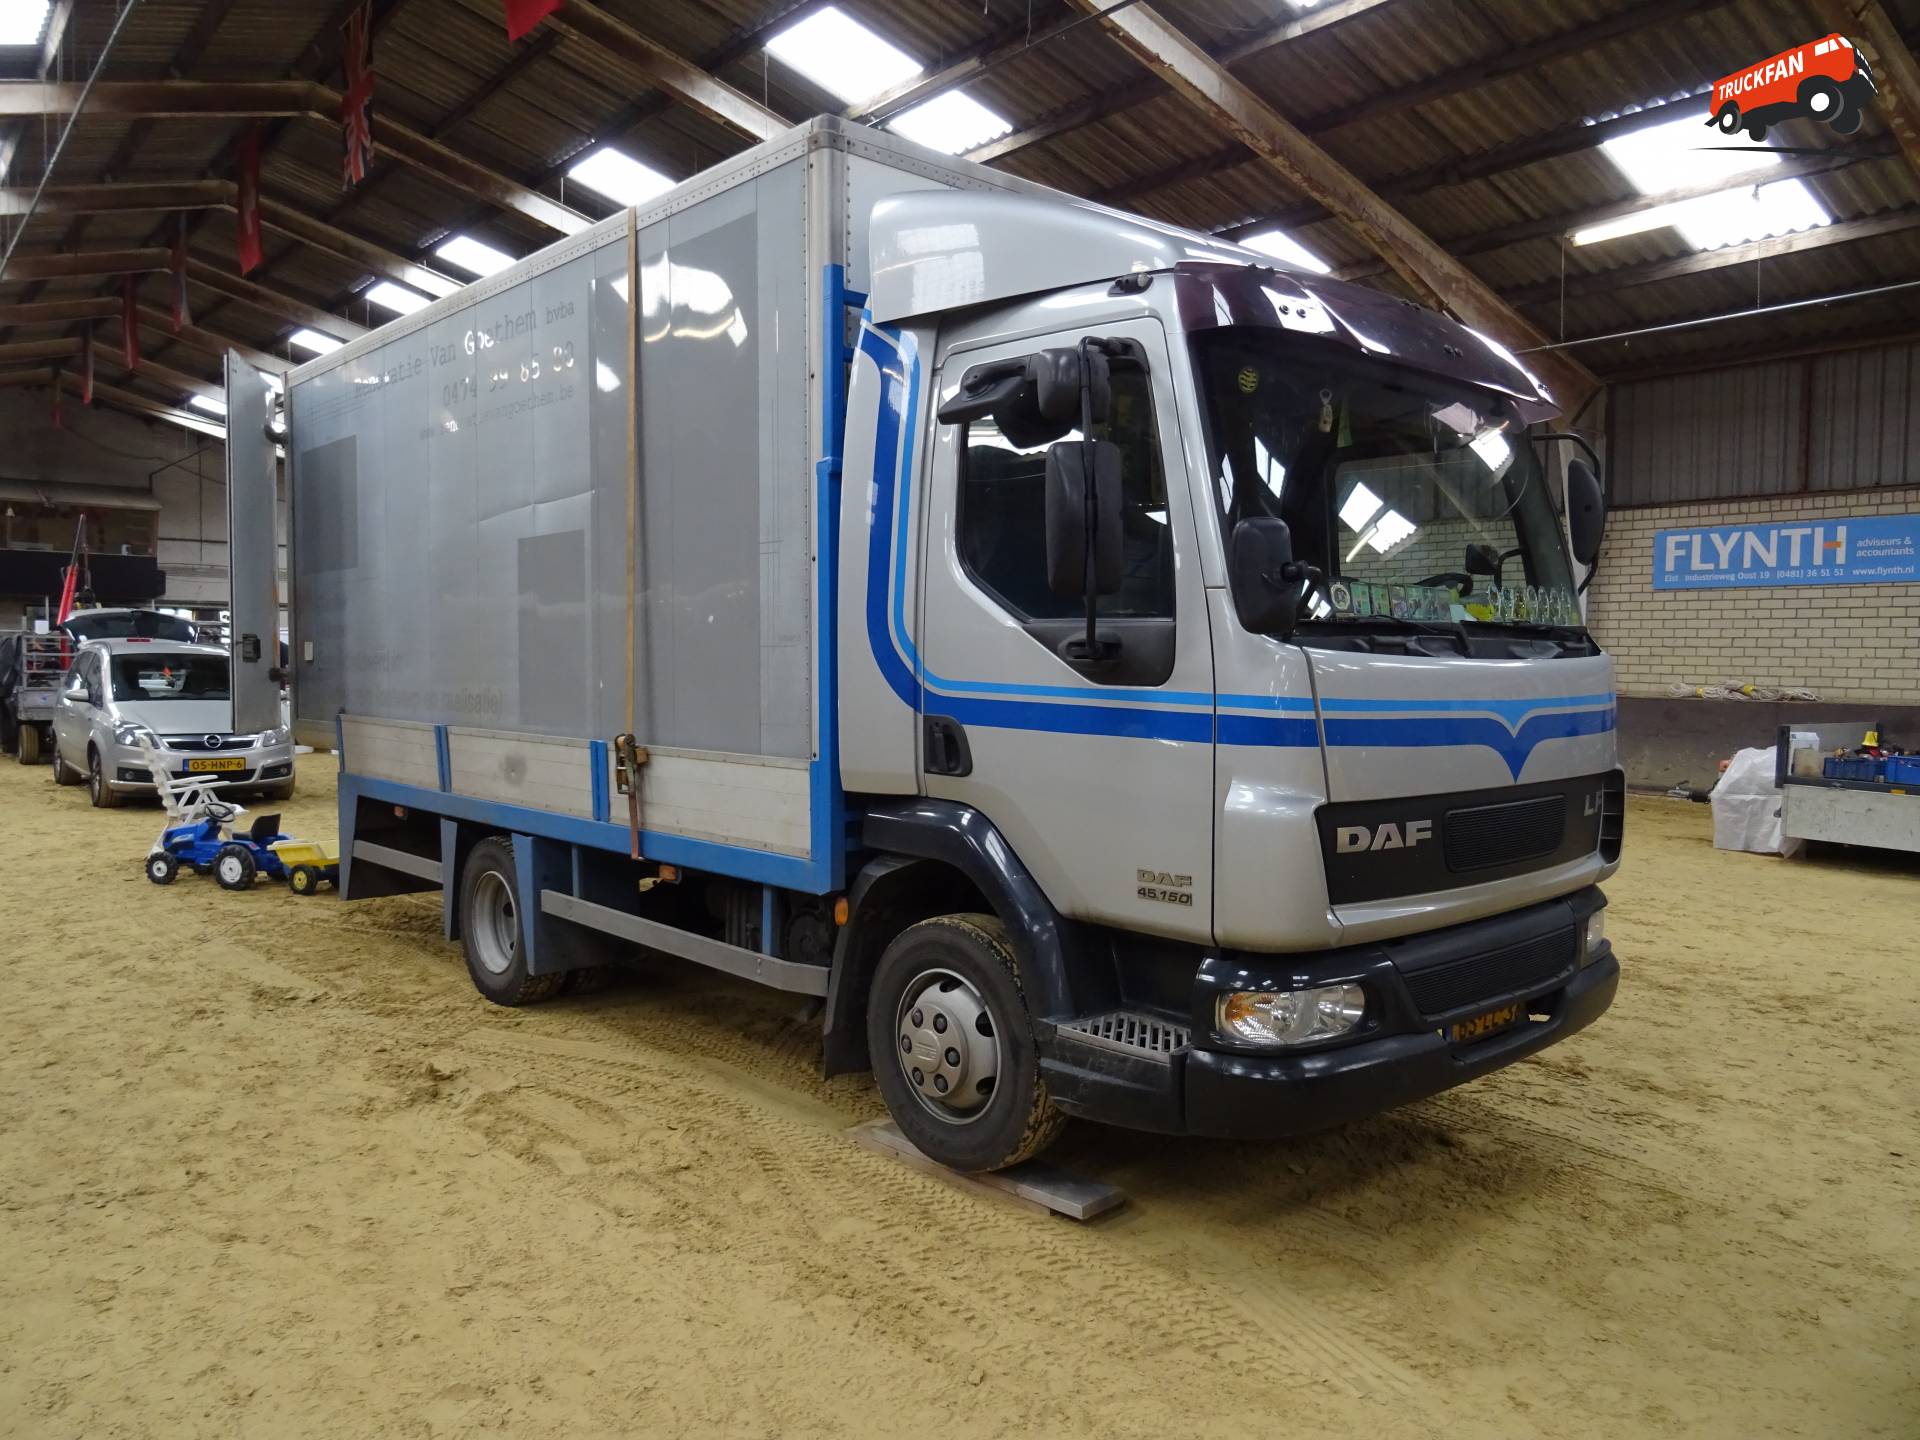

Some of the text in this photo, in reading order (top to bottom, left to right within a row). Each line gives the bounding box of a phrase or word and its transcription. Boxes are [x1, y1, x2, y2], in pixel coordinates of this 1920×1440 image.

[430, 344, 456, 368] Van
[464, 309, 537, 355] Goethem
[545, 301, 575, 325] bvba
[1856, 536, 1912, 548] adviseurs &
[1664, 525, 1847, 572] FLYNTH
[1855, 546, 1915, 557] accountants
[1759, 571, 1770, 579] 19
[1806, 569, 1817, 577] 36
[1834, 568, 1844, 576] 51
[1852, 566, 1915, 576] www.flynth.nl
[192, 760, 243, 770] 05-HNP-6
[1336, 819, 1432, 853] DAF
[1137, 869, 1192, 888] DAF
